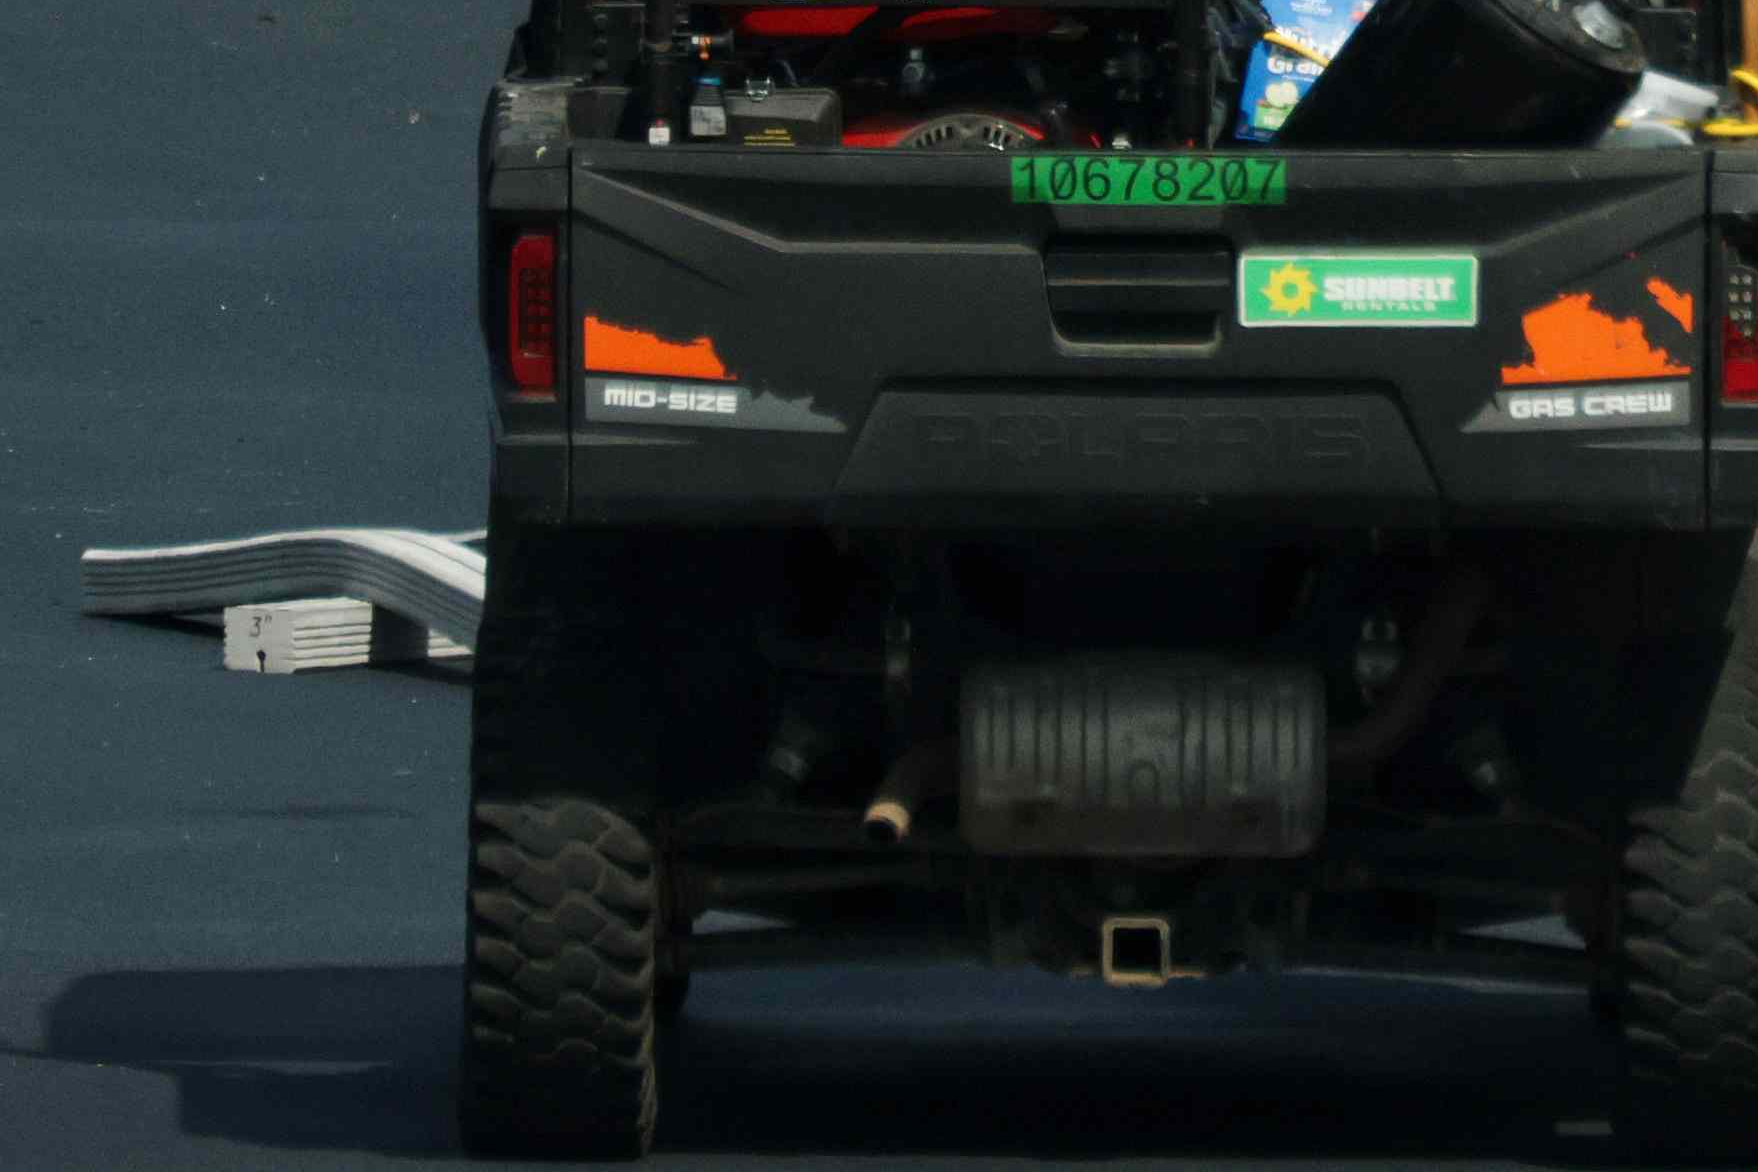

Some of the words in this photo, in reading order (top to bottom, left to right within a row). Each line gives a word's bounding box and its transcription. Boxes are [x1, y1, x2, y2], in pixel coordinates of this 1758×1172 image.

[1018, 158, 1282, 202] 10678207
[1323, 275, 1456, 302] SUNBELT
[603, 384, 738, 414] MID-SIZE
[1508, 396, 1576, 419] GAS
[1583, 392, 1673, 416] CREW
